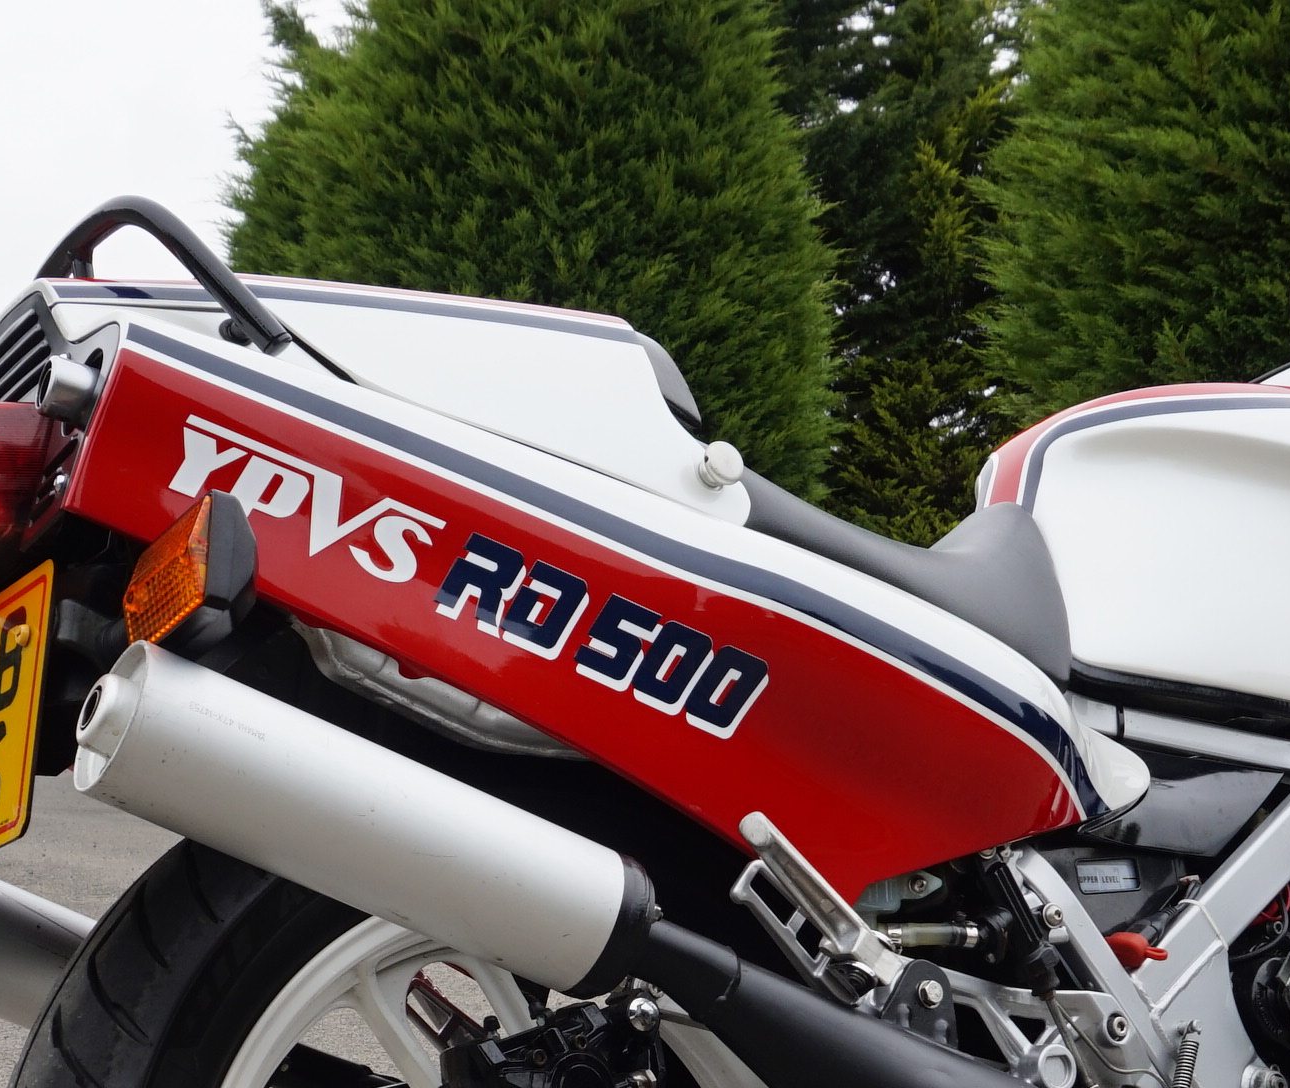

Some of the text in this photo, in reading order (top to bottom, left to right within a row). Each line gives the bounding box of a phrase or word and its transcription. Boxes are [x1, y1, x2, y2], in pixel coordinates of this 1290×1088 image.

[168, 414, 446, 583] YPVS
[434, 532, 768, 740] RD 500
[1078, 875, 1120, 884] UPPER LEVEL
